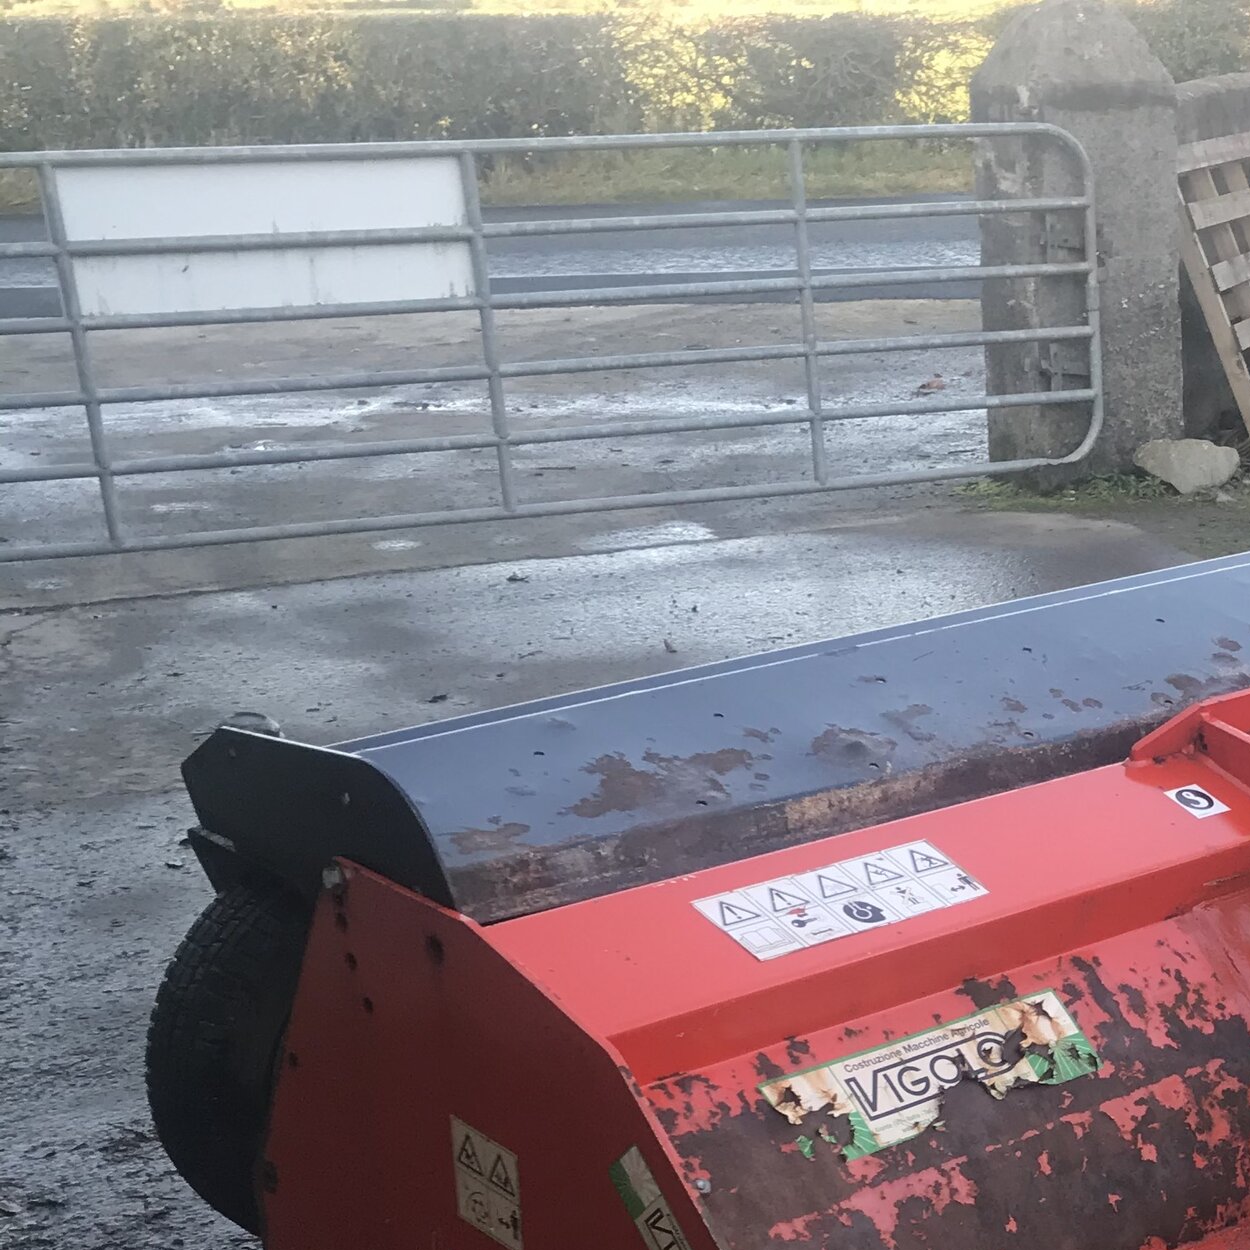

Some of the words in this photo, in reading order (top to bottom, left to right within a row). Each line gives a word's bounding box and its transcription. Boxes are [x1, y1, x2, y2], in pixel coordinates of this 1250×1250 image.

[843, 1048, 903, 1073] Costruzione
[902, 1032, 950, 1055] Macchine
[950, 1016, 990, 1039] Agricole
[845, 1034, 1008, 1117] VIGOLO
